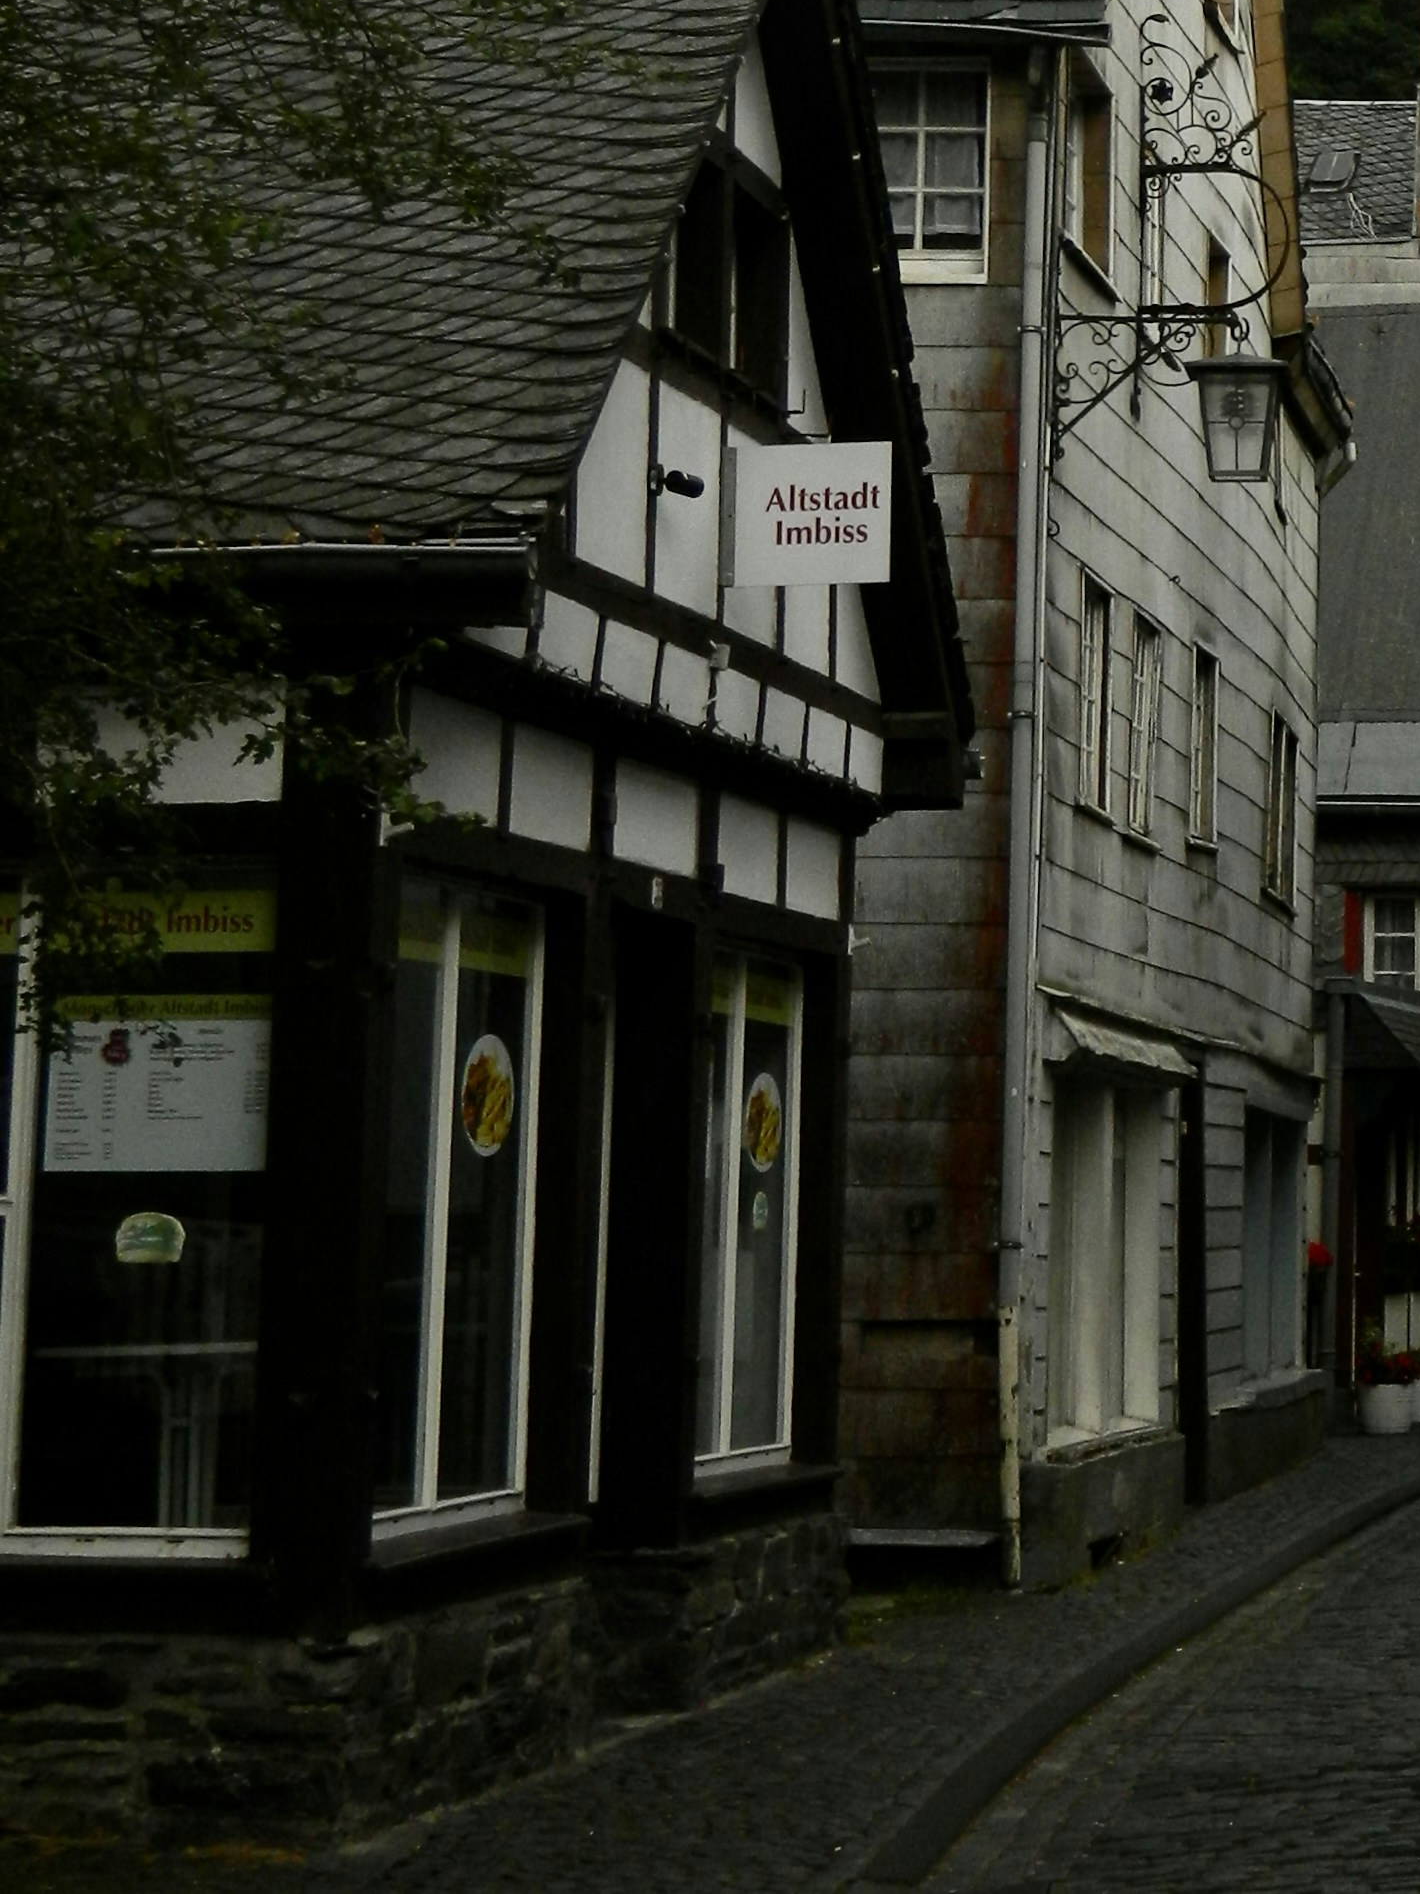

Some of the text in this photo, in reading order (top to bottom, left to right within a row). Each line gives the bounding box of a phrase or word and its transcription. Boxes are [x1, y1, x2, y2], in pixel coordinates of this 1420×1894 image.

[765, 482, 880, 513] Altstadt
[775, 517, 868, 546] Imbiss
[166, 905, 254, 934] Imbiss
